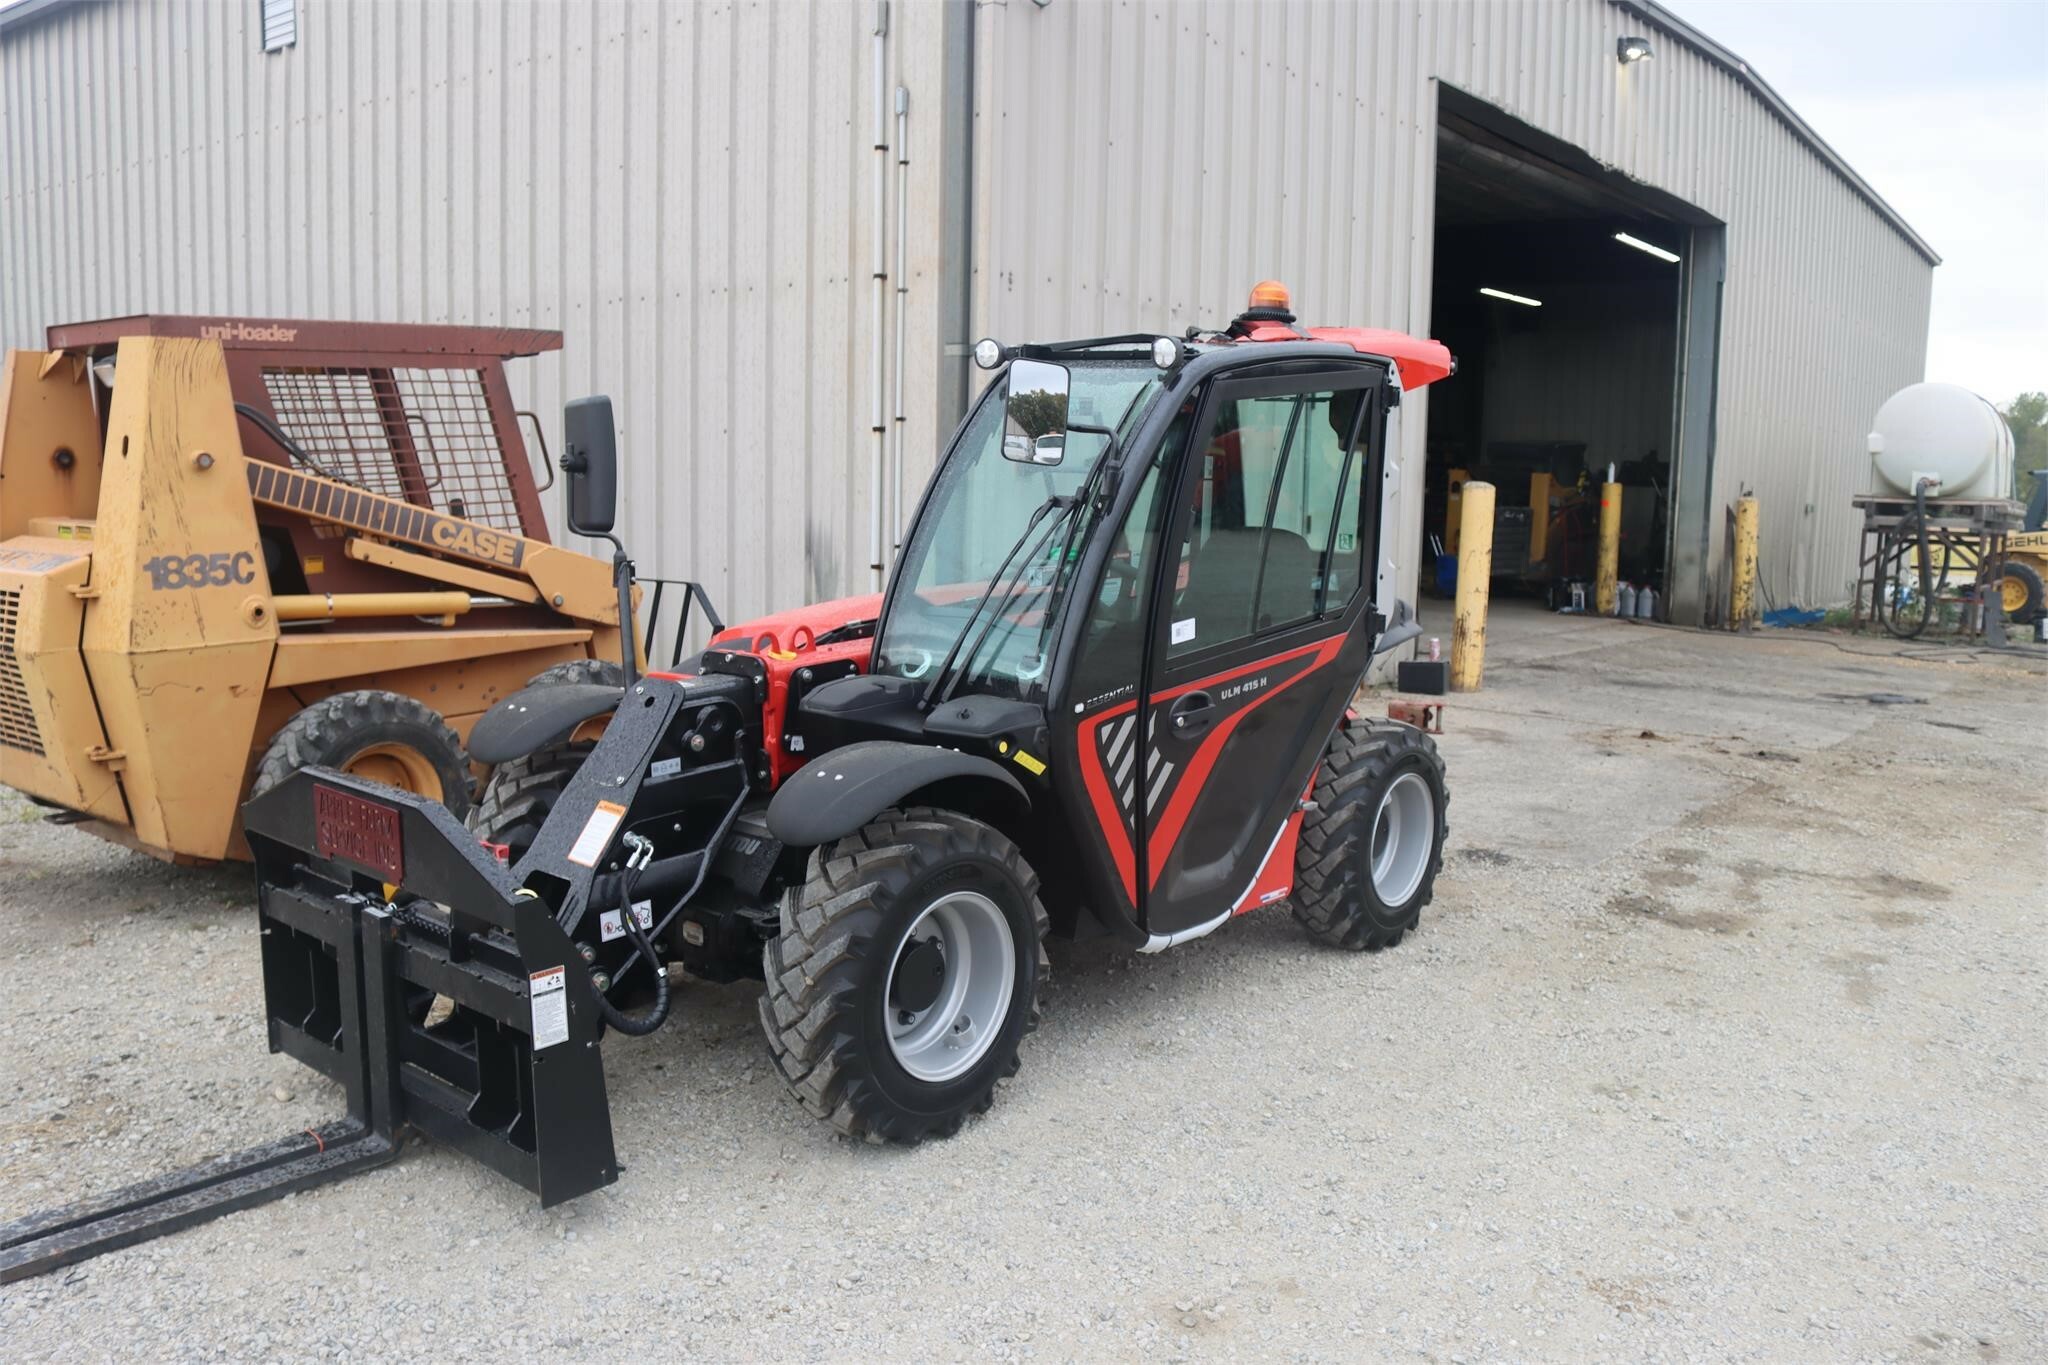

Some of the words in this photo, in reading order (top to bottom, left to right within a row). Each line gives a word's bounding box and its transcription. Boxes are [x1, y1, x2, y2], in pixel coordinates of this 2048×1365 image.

[201, 322, 297, 342] uni-loader
[432, 520, 517, 566] CASE
[143, 552, 255, 591] 1835C
[1221, 685, 1241, 700] ULM
[1242, 680, 1259, 692] 415
[1260, 676, 1267, 687] H
[320, 792, 355, 825] APPLE
[360, 804, 394, 838] FARM
[320, 821, 368, 862] SERVICE
[374, 840, 397, 871] INC
